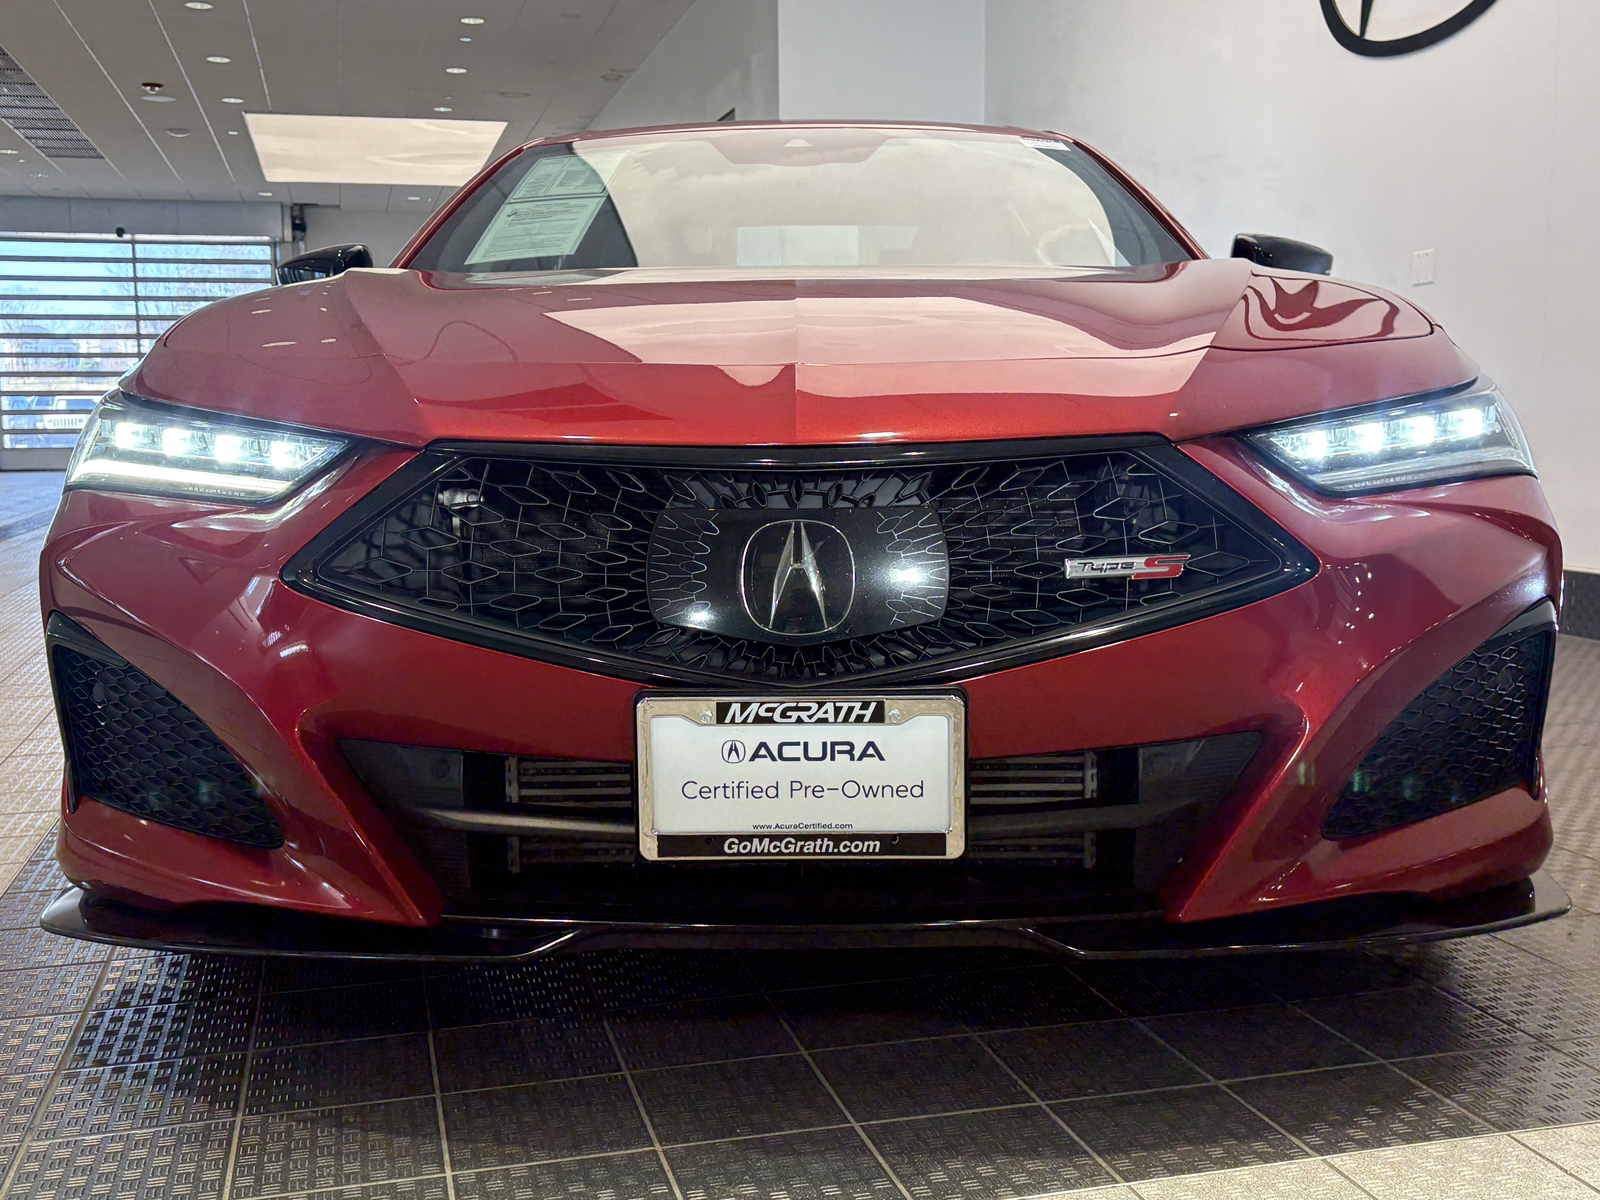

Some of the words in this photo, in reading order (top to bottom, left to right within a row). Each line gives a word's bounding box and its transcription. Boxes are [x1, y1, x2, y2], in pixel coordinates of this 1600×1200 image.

[1077, 562, 1137, 573] Type
[1132, 553, 1191, 580] S
[748, 741, 886, 762] ACURA
[681, 780, 780, 800] Certified
[789, 779, 924, 799] Pre-Owned
[752, 822, 853, 830] www.AcuraCertified.com
[723, 837, 881, 854] GoMcGrath.com
